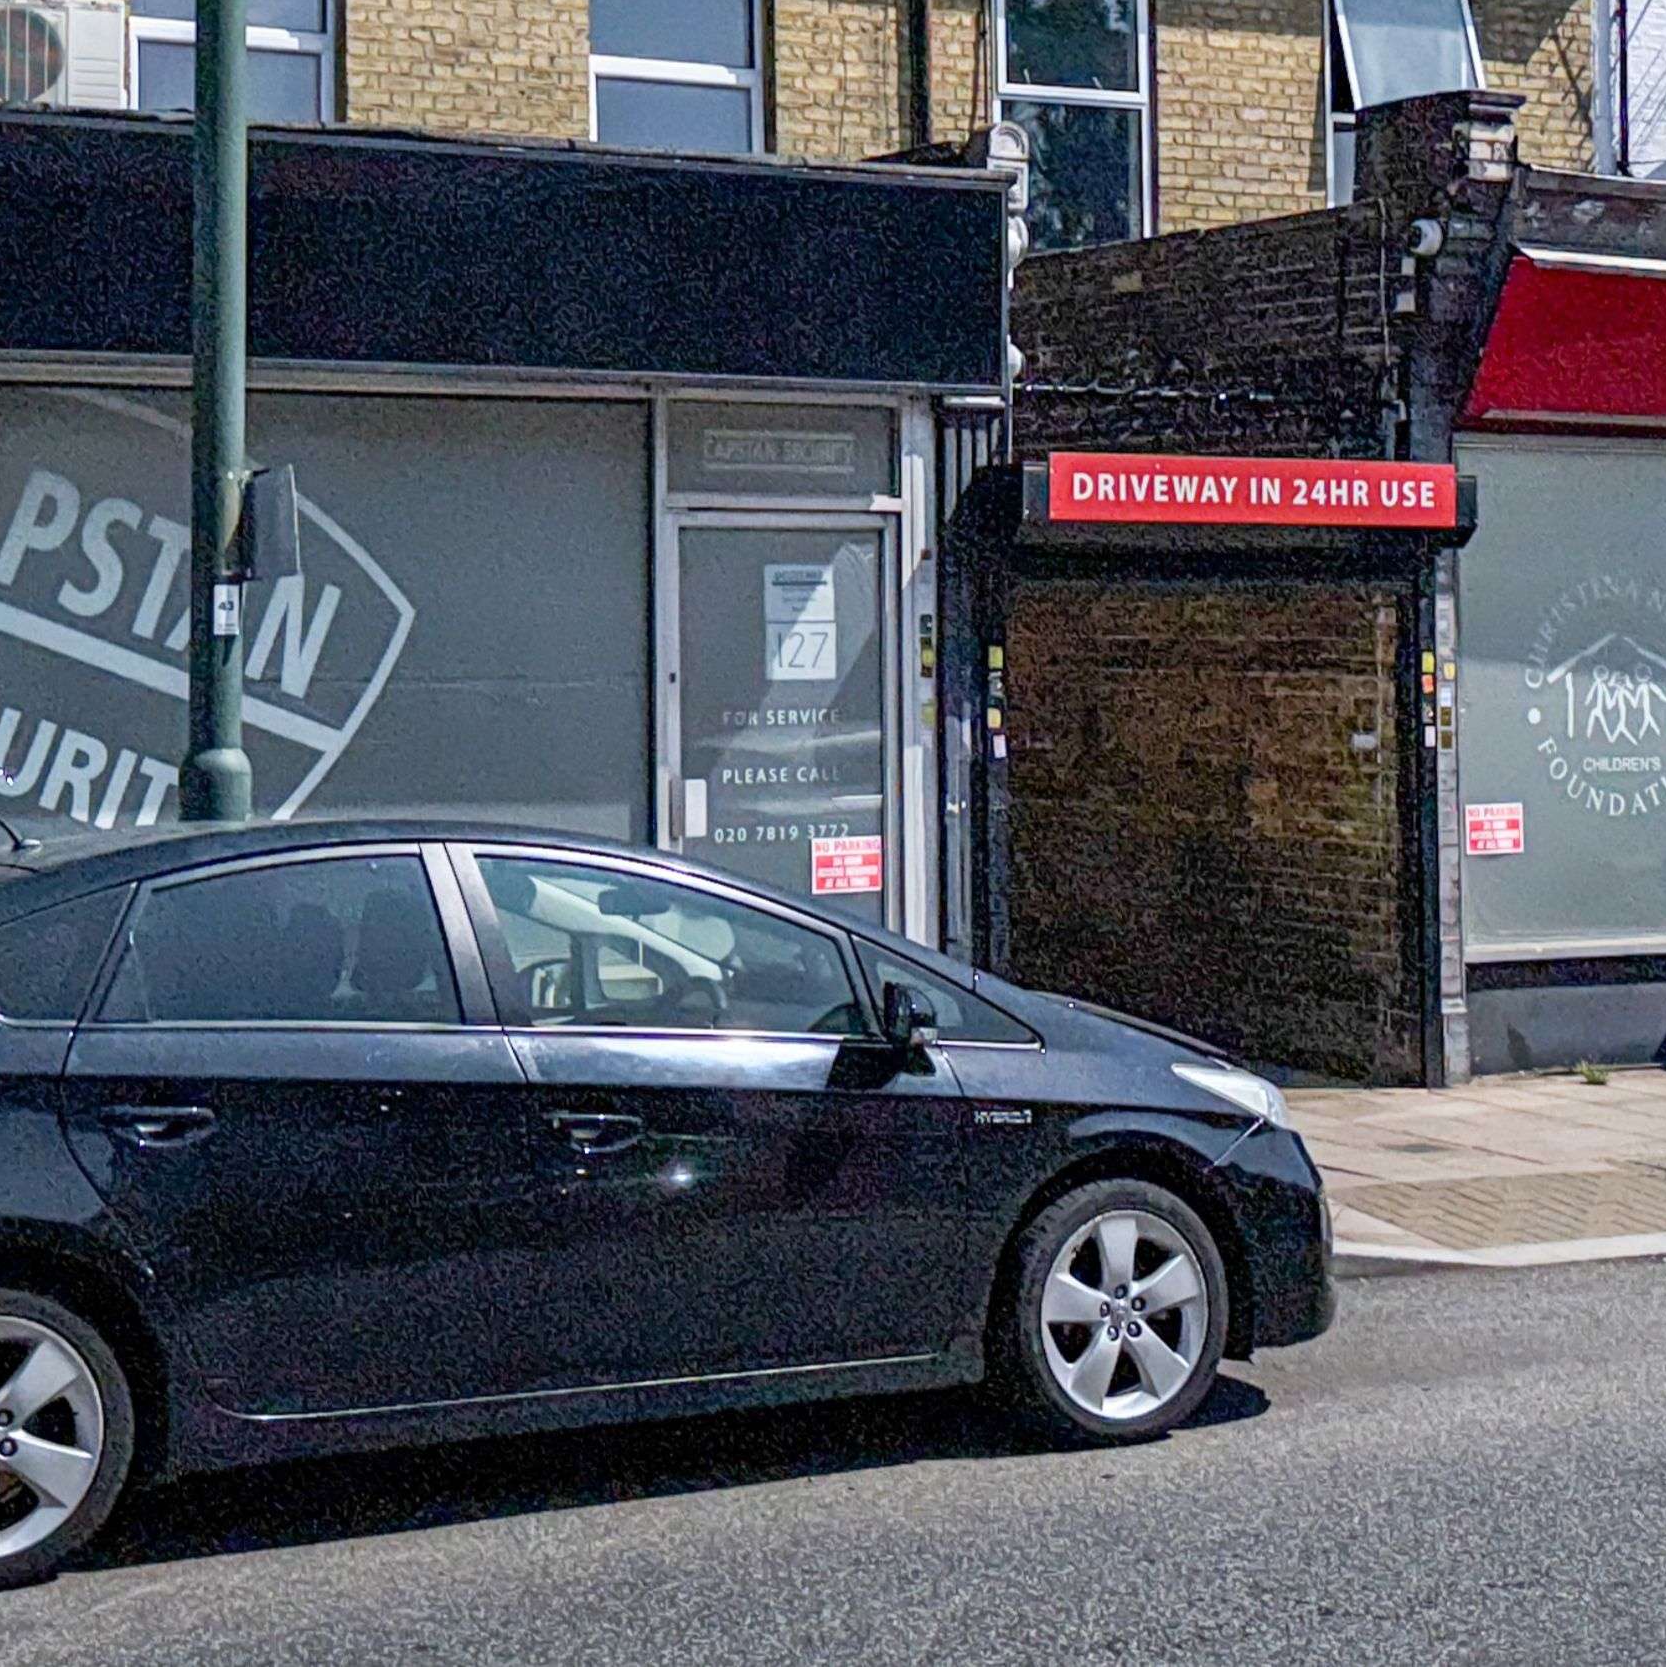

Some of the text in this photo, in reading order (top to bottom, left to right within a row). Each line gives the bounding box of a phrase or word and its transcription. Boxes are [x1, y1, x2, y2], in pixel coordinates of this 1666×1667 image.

[1073, 472, 1435, 509] DRIVEWAY IN 24HR USE
[778, 632, 829, 668] 127
[766, 708, 840, 725] SERVICE
[1583, 756, 1661, 773] CHILDREN'S
[722, 767, 788, 784] PLEASE
[714, 827, 747, 844] 020
[756, 825, 799, 841] 7819
[814, 838, 882, 853] NO PARKING
